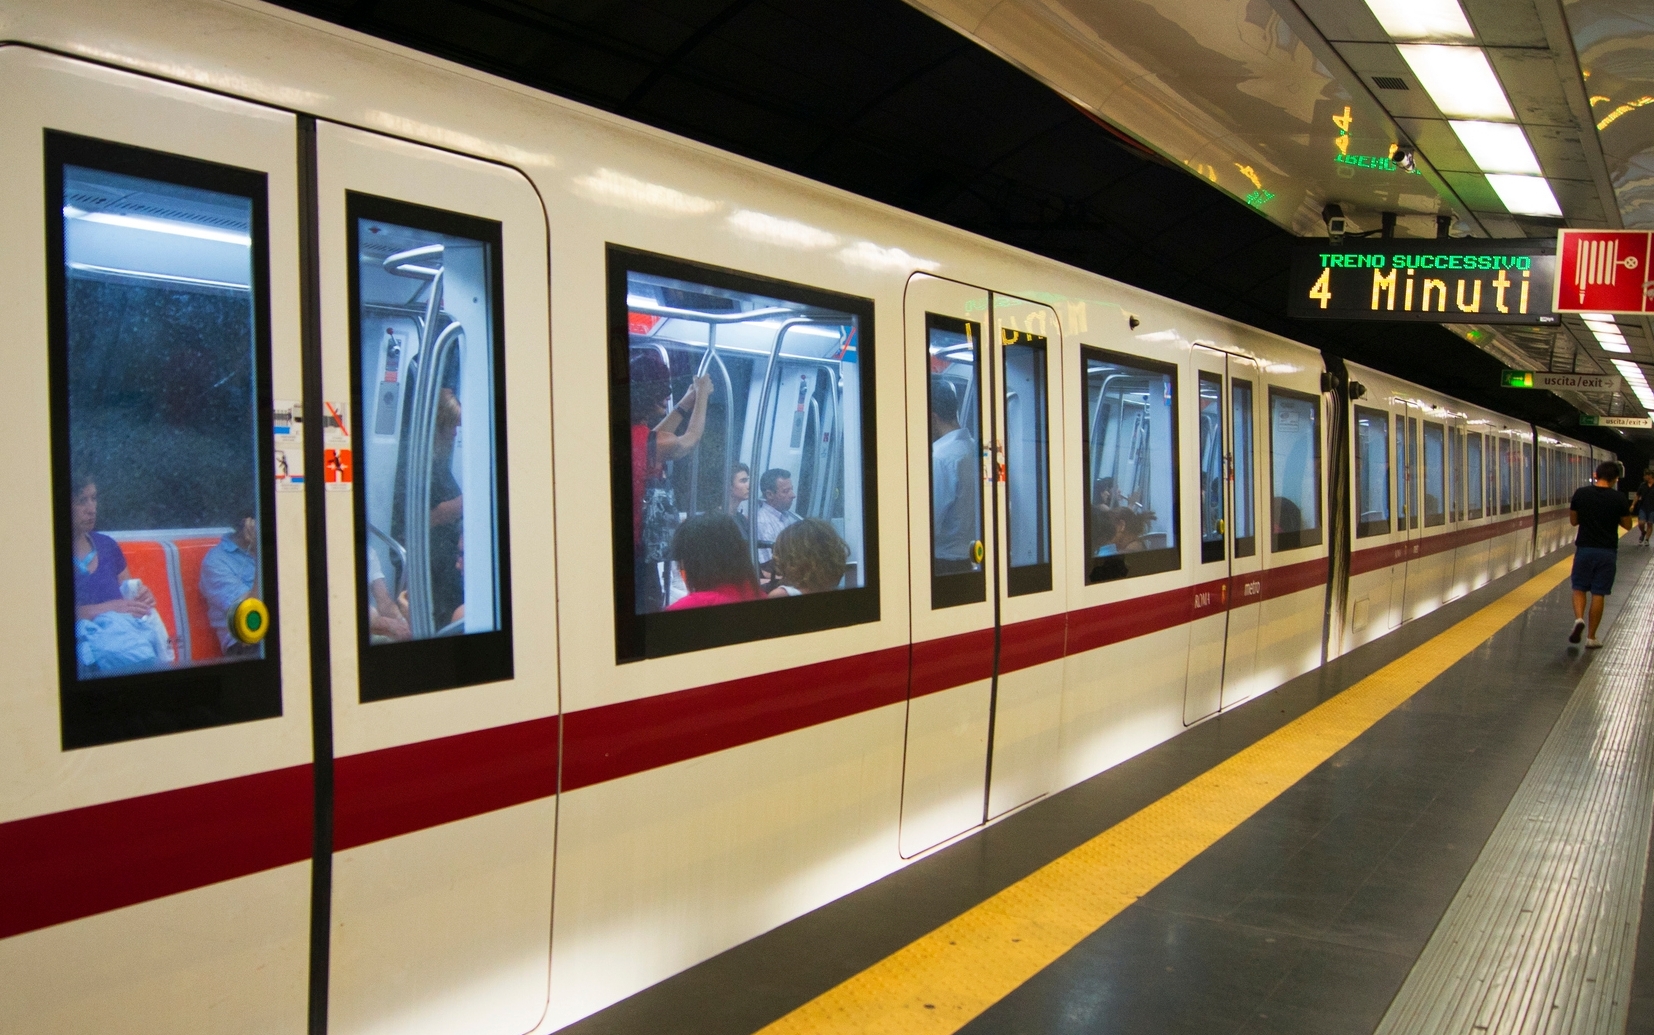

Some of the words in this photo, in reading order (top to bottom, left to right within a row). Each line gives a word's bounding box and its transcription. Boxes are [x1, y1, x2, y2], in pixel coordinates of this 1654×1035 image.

[1319, 254, 1385, 268] TRENO
[1392, 254, 1531, 270] SUCCESSIVO
[1309, 267, 1332, 309] 4
[1371, 268, 1530, 314] Minuti
[1544, 376, 1603, 388] uscita/exit
[1244, 580, 1261, 597] metro
